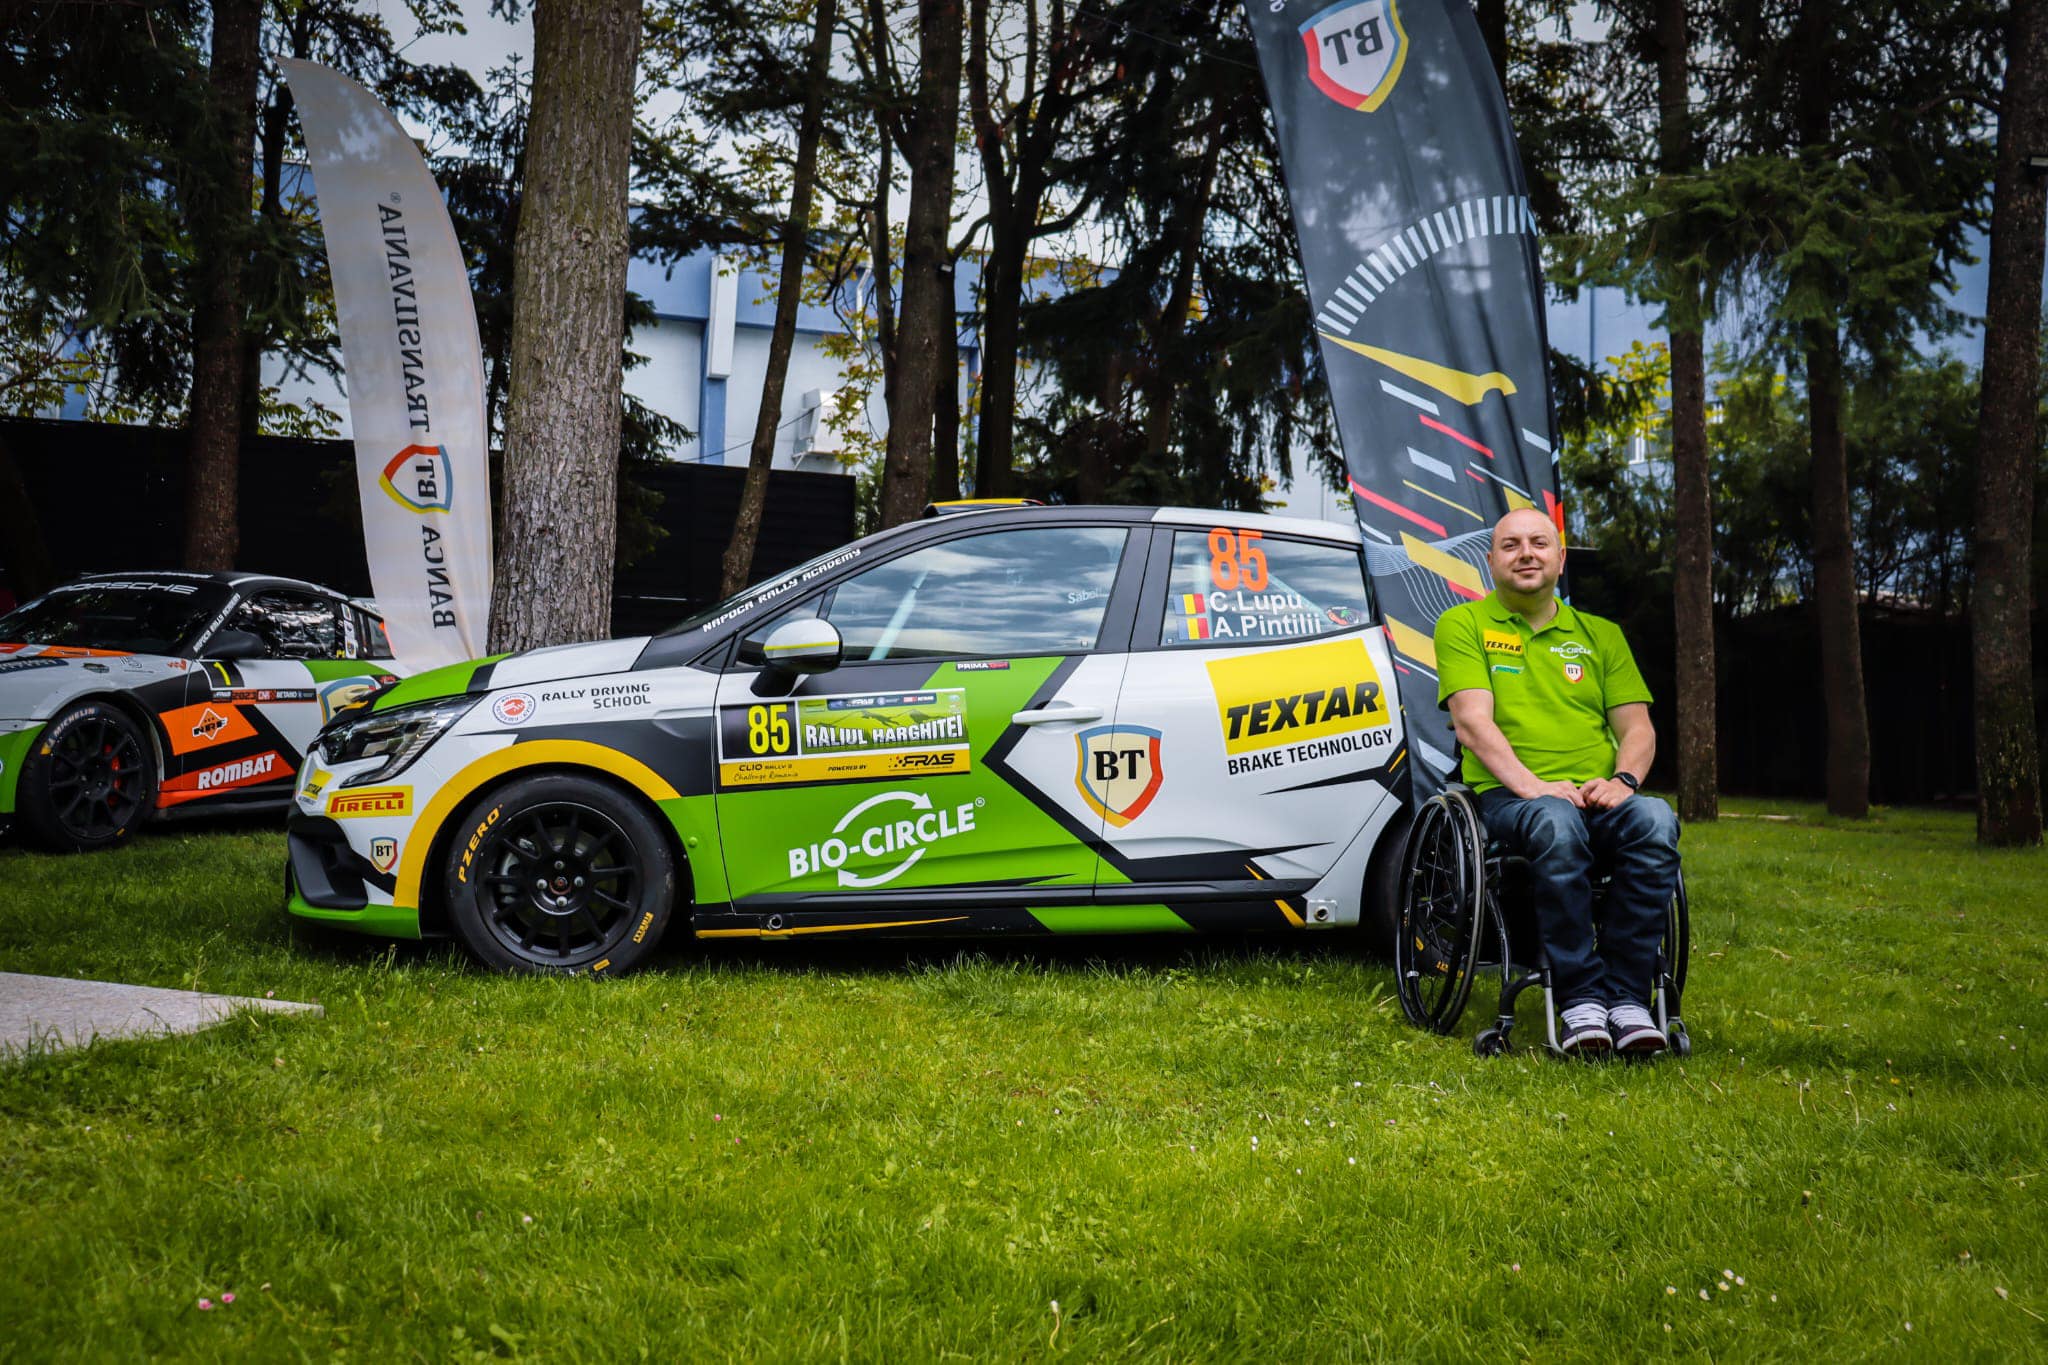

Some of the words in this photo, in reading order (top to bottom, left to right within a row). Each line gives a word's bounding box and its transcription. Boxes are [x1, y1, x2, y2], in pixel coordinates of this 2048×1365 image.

[1207, 527, 1269, 592] 85
[702, 602, 754, 633] NAPOCA
[757, 578, 799, 604] RALLY
[802, 547, 861, 582] ACADEMY
[1209, 591, 1303, 615] C.Lupu
[1214, 614, 1323, 638] A.Pintilii
[1485, 640, 1522, 653] TEXTAR
[213, 661, 233, 686] 1
[1567, 667, 1579, 675] BT
[542, 689, 587, 703] RALLY
[591, 683, 651, 698] DRIVING
[593, 694, 652, 710] SCHOOL
[53, 706, 96, 737] MICHELIN
[1226, 682, 1380, 741] TEXTAR
[748, 704, 791, 754] 85
[804, 723, 869, 748] RALIUL
[872, 714, 963, 744] HARGHITEI
[900, 752, 955, 767] FRAS
[1227, 751, 1284, 776] BRAKE
[1286, 728, 1393, 764] TECHNOLOGY
[197, 753, 276, 790] ROMBAT
[739, 763, 763, 772] CLIO
[1093, 749, 1145, 781] BT
[330, 791, 405, 814] PIRELLI
[375, 845, 393, 857] BT
[788, 802, 976, 879] BIO-CIRCLE
